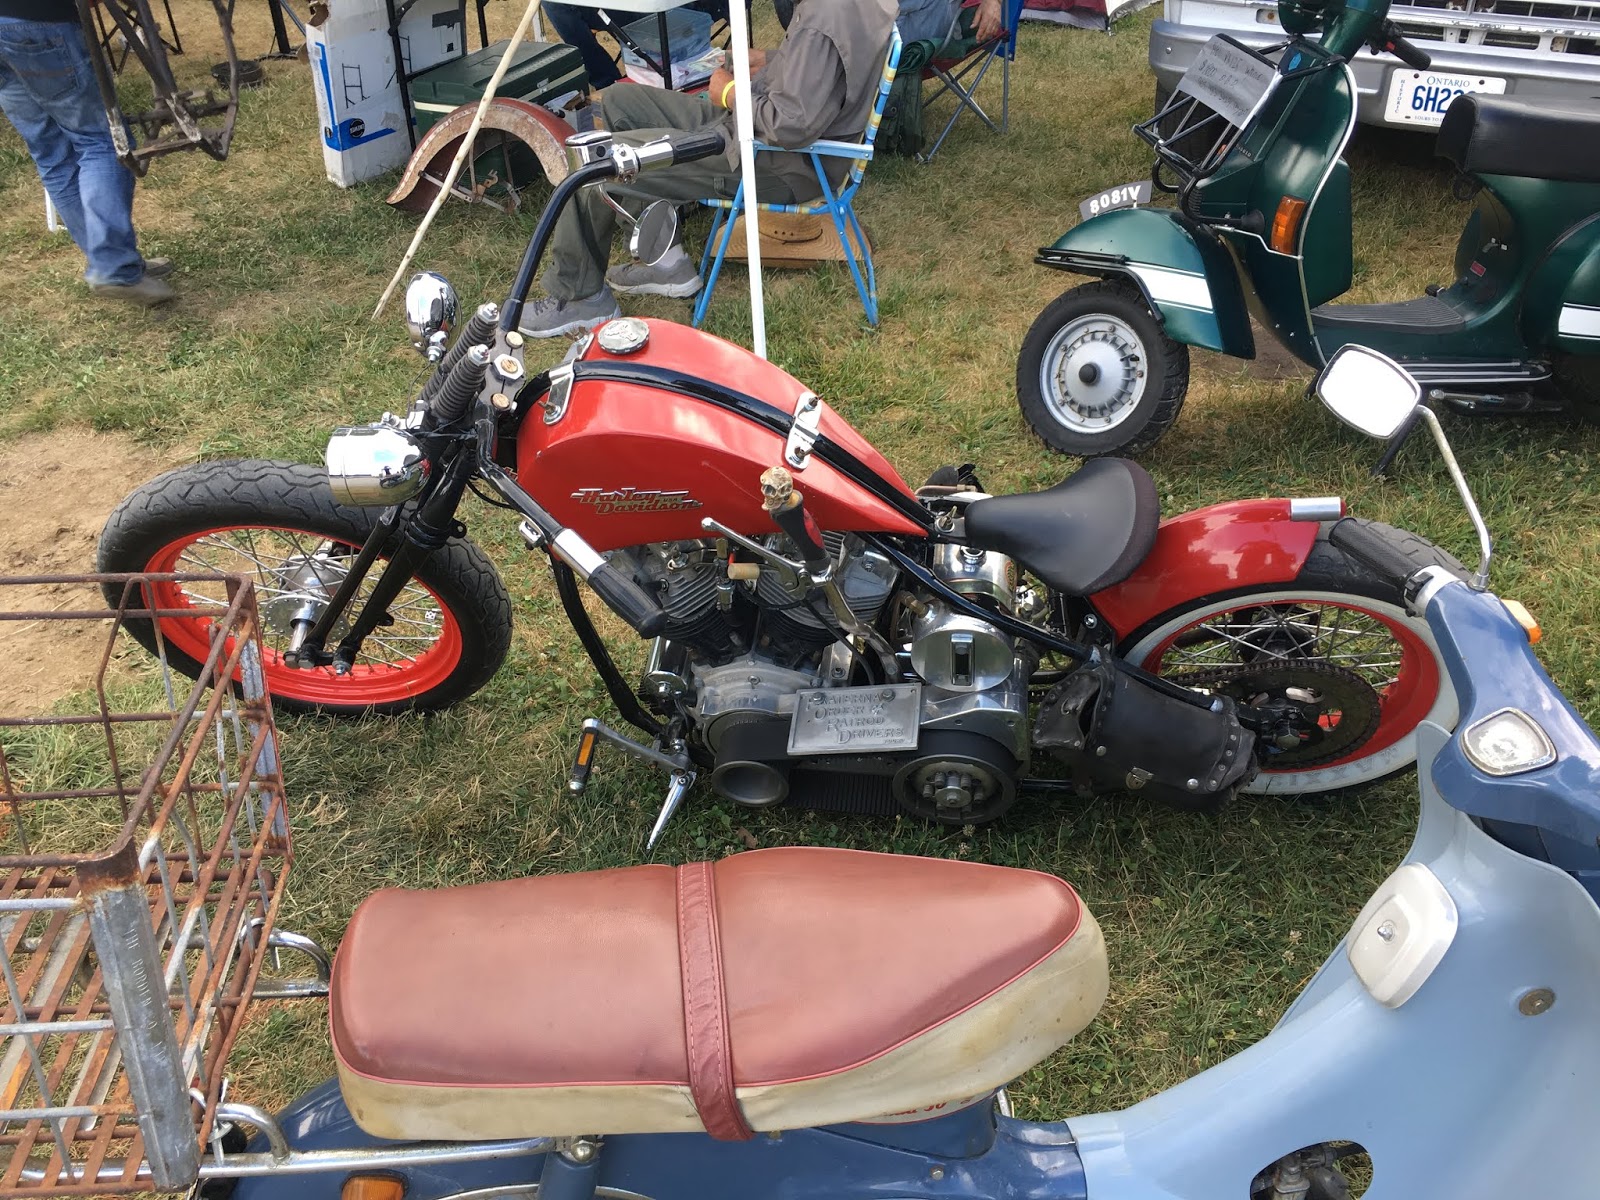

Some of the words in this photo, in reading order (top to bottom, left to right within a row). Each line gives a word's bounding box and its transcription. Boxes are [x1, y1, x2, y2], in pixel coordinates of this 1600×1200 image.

[1427, 76, 1470, 87] ONTARIO
[1411, 85, 1476, 113] 6H2
[1089, 185, 1141, 214] 8081V
[571, 488, 662, 505] Harley
[596, 499, 702, 514] Davidson
[837, 727, 904, 745] DRIVERS
[123, 928, 139, 950] THE
[132, 958, 152, 1007] BORDEN
